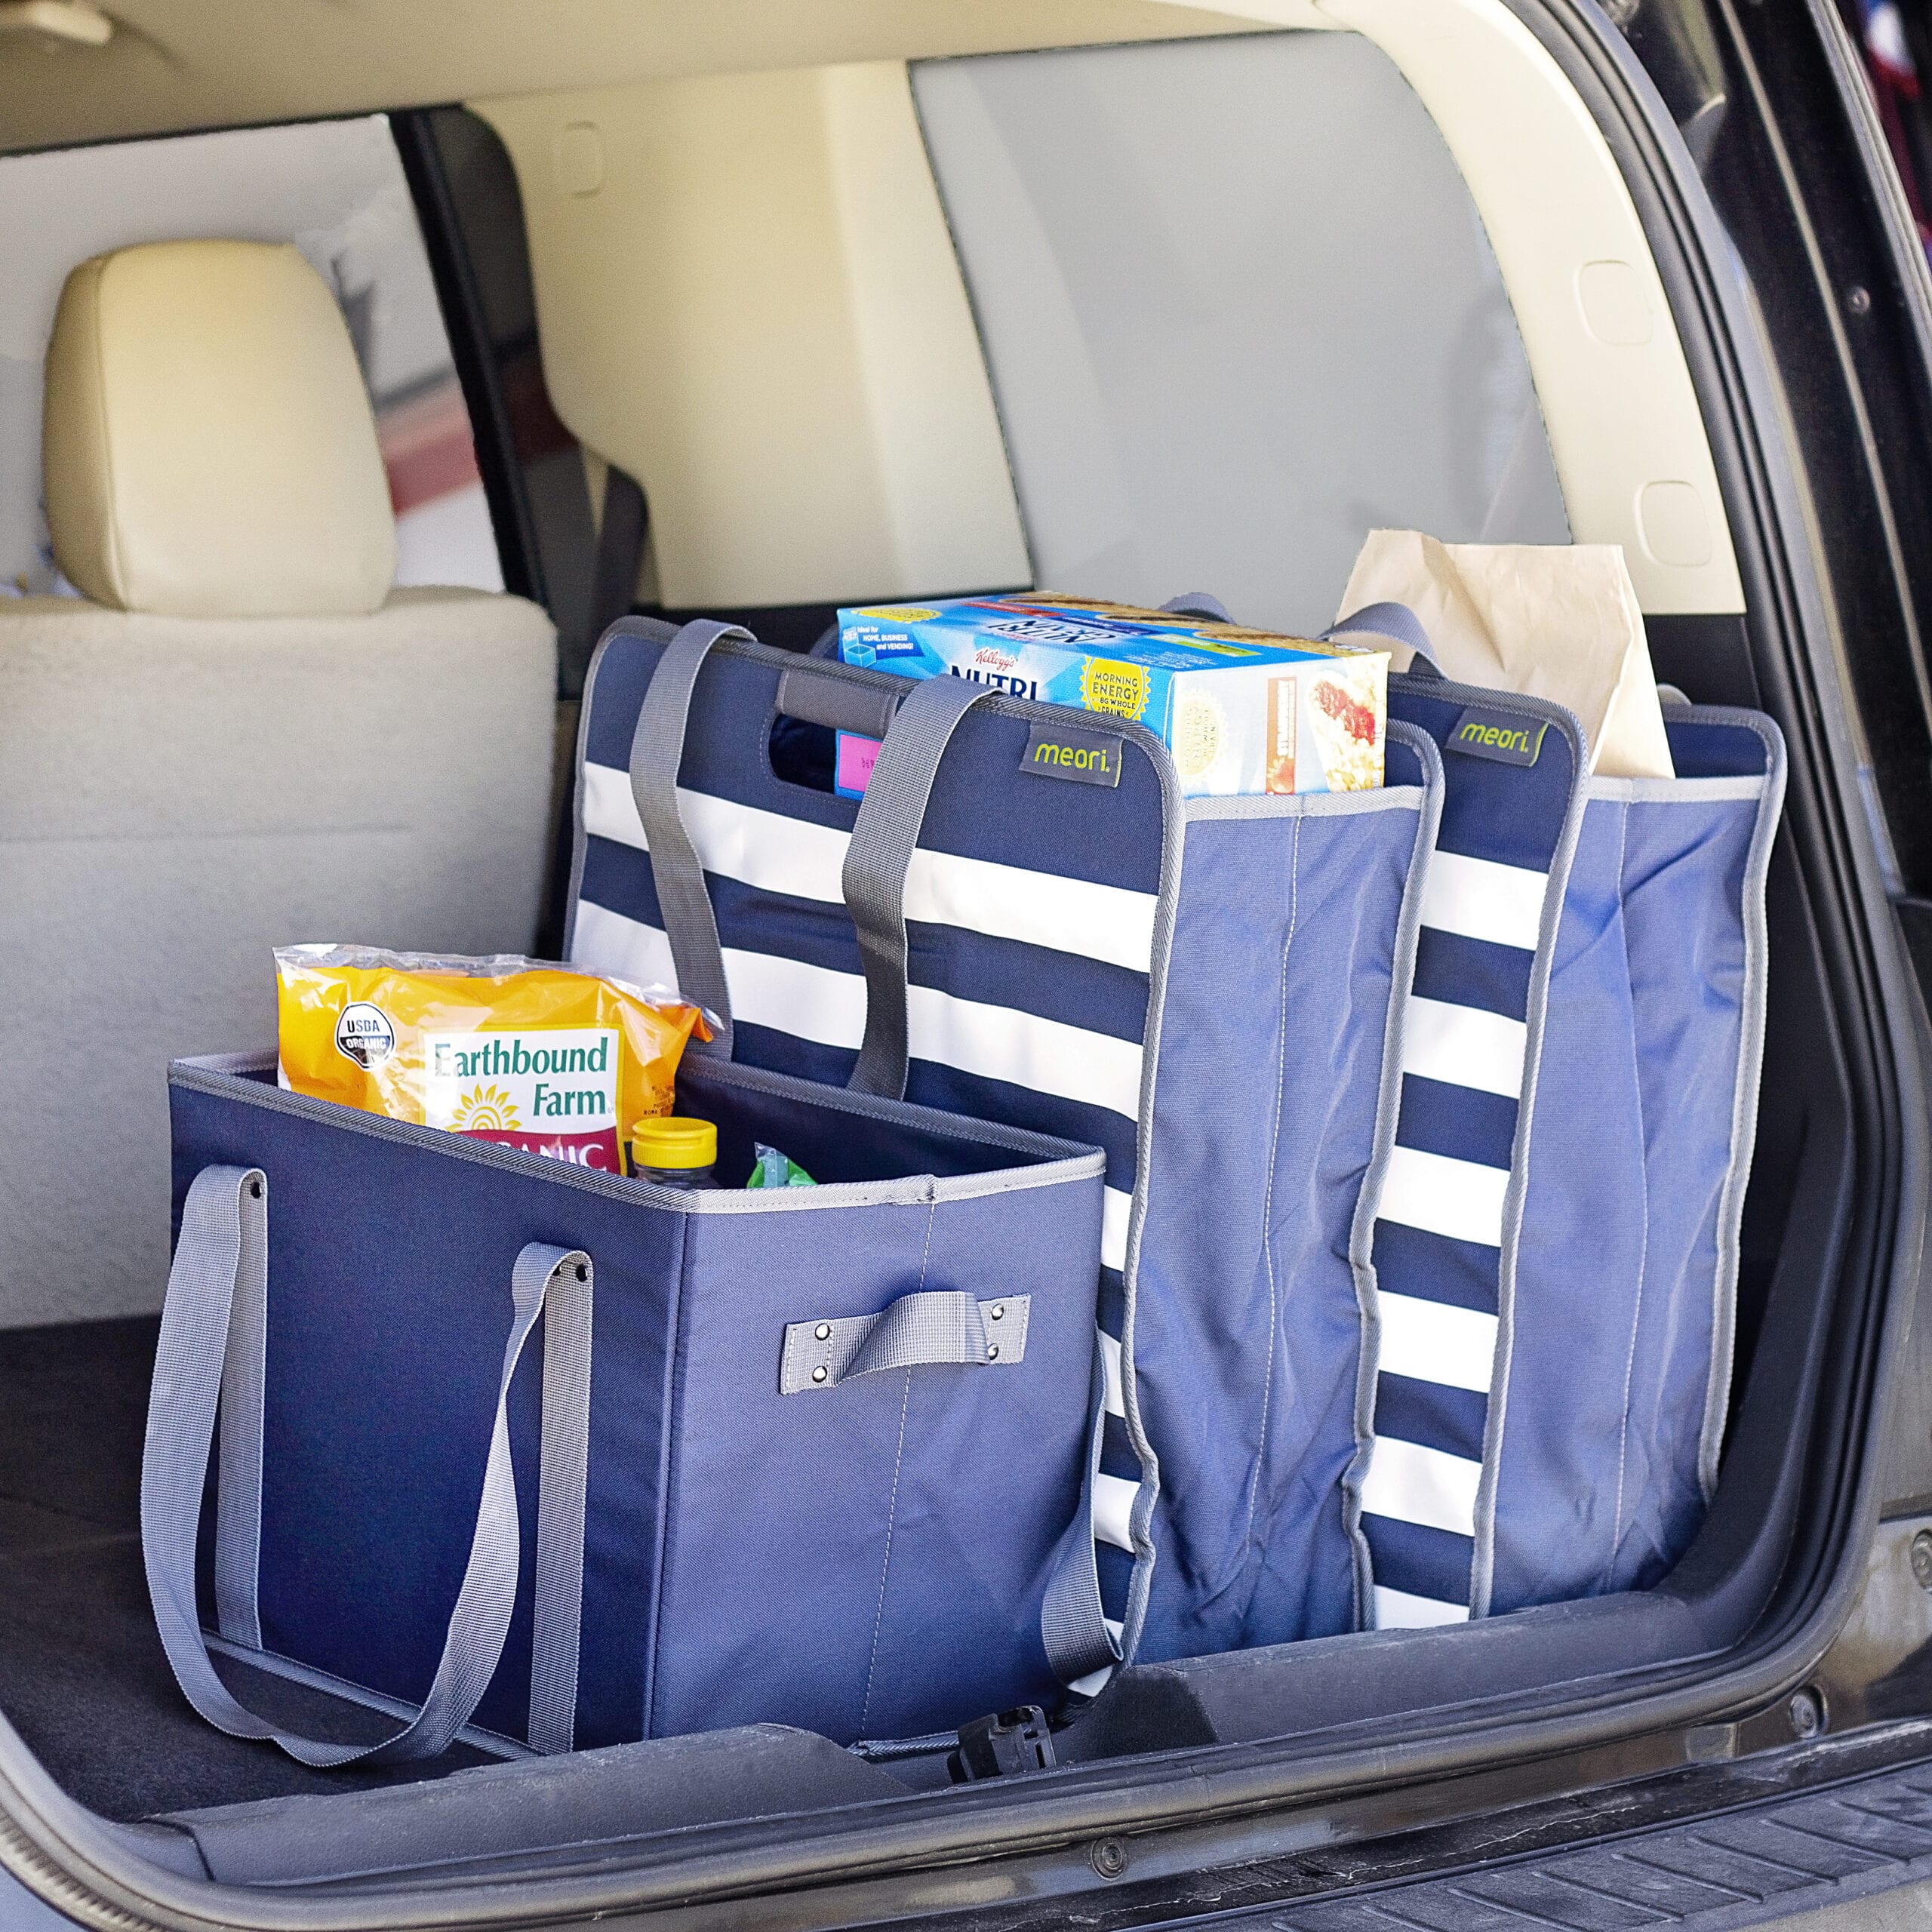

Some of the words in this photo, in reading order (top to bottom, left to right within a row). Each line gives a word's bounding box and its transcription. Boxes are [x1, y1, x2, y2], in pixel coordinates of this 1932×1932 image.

[975, 648, 1015, 671] Kellogg's
[1095, 672, 1138, 687] MORNING
[1093, 682, 1139, 700] ENERGY
[1110, 699, 1136, 709] WHOLE
[347, 1020, 380, 1032] USDA
[346, 1038, 387, 1050] ORGANIC
[435, 1037, 608, 1077] Earthbound
[534, 1083, 606, 1116] Farm
